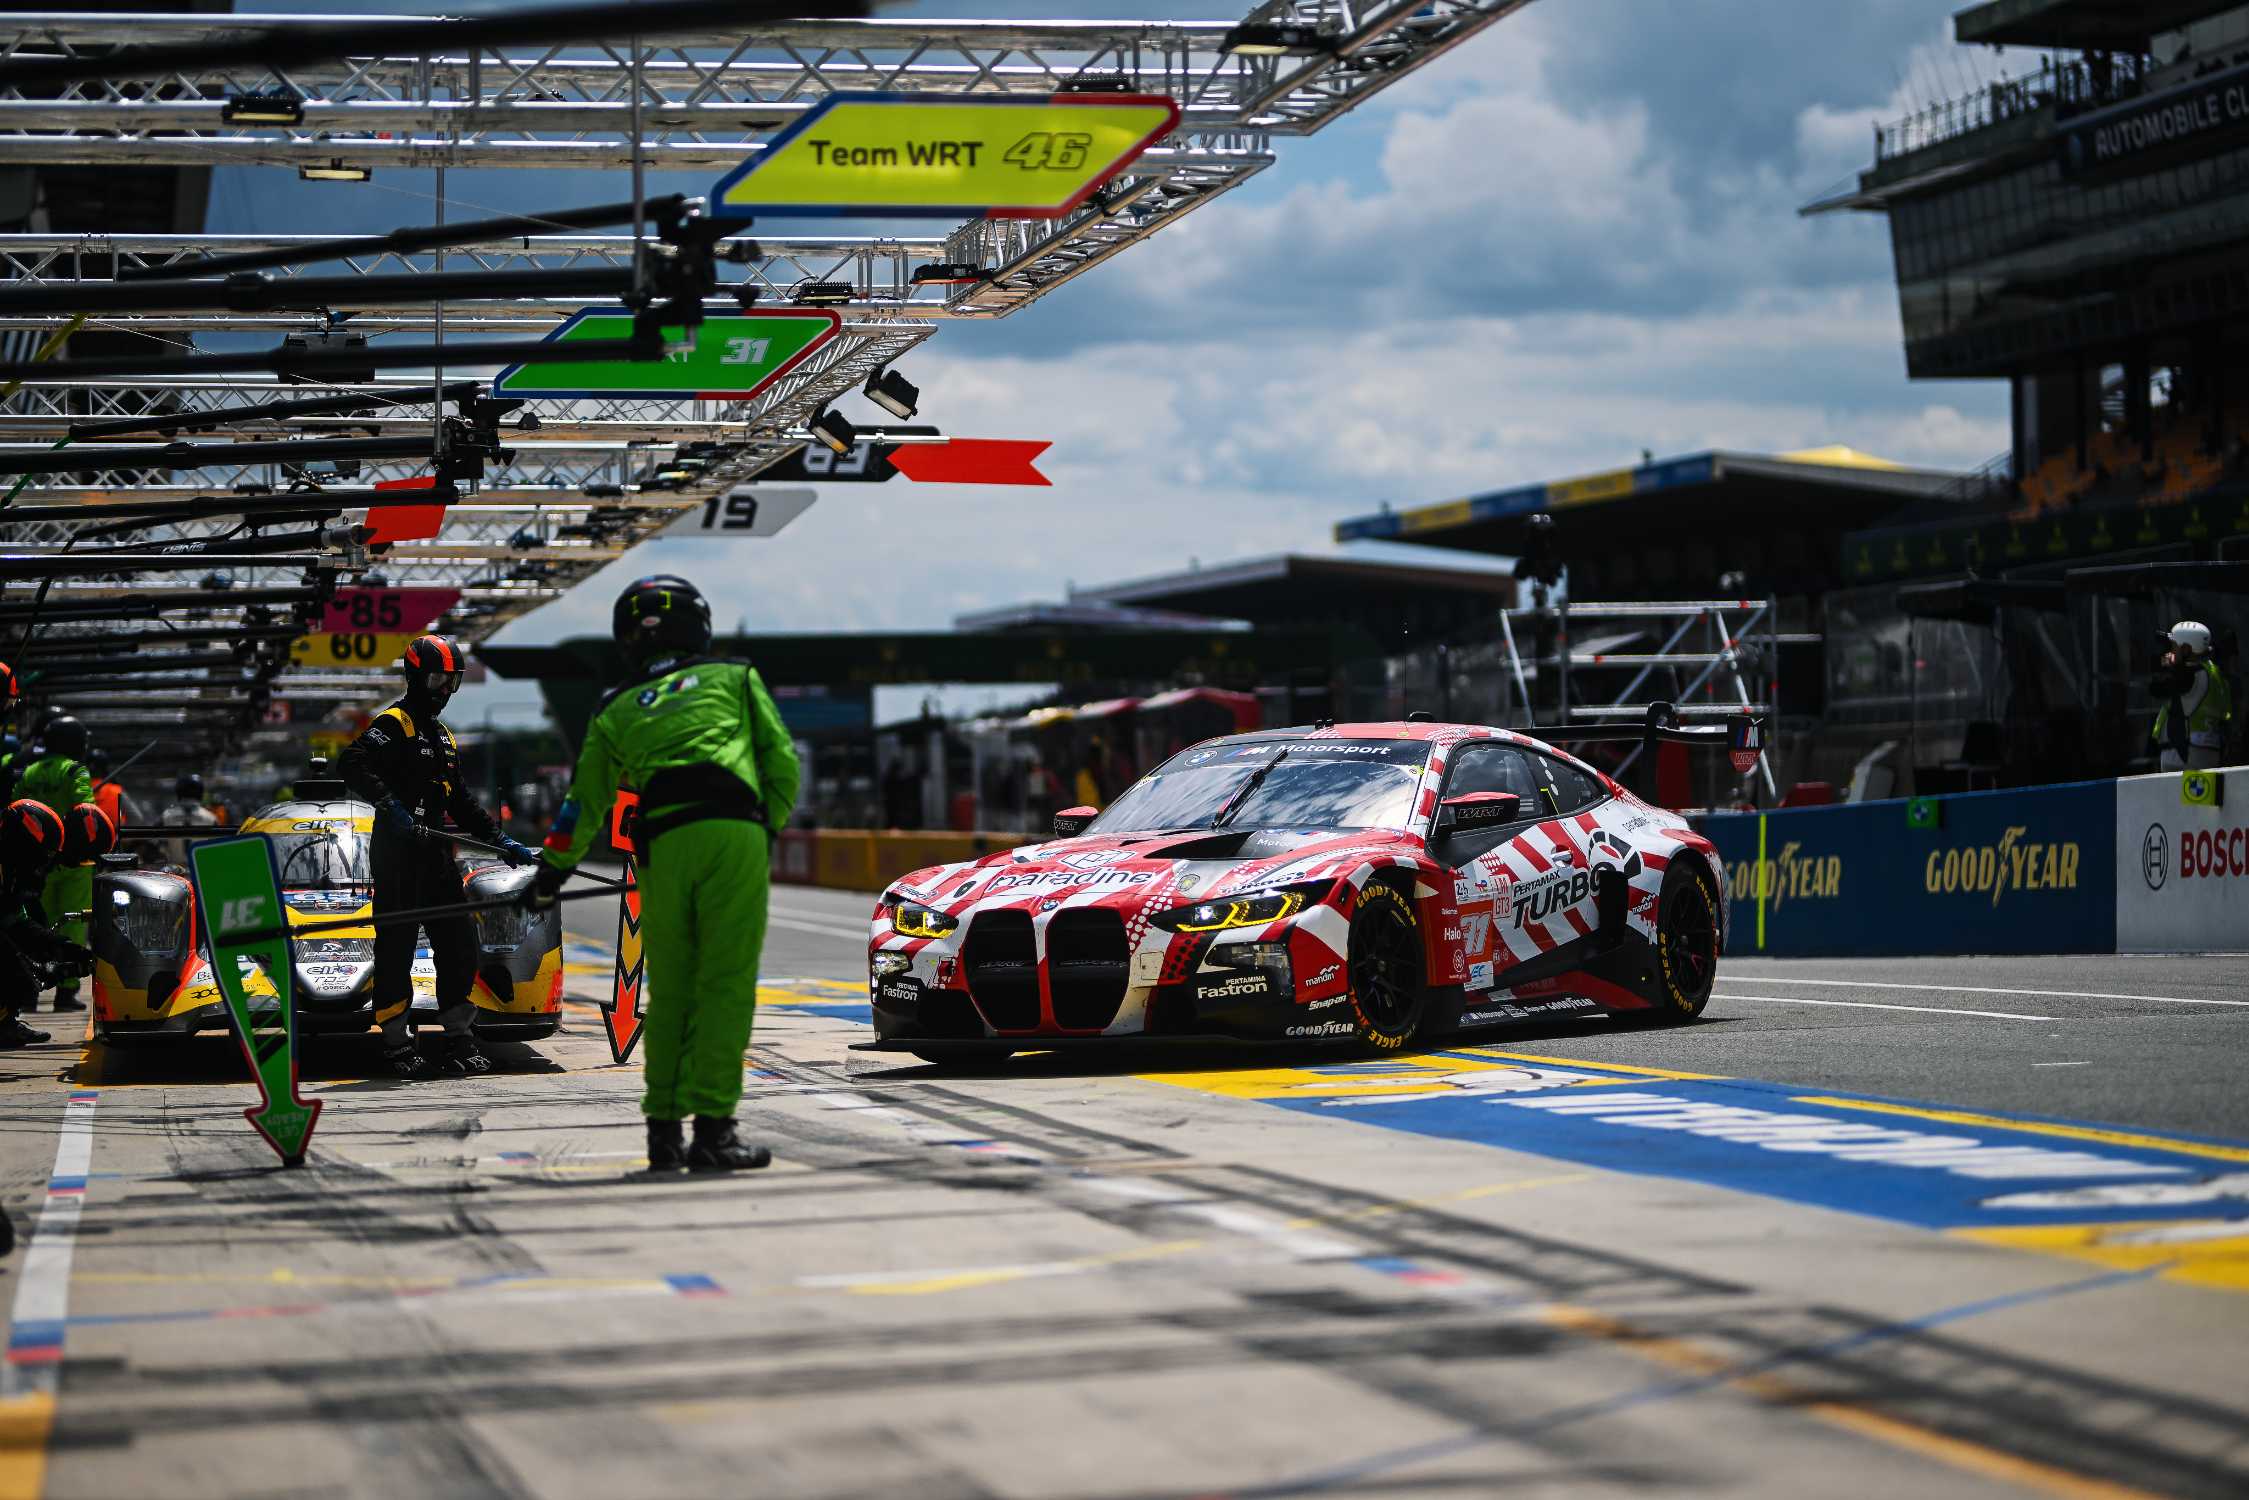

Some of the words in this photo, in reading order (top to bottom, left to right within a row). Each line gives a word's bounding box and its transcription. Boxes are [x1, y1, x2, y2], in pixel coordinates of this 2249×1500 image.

[2095, 93, 2221, 158] AUTOMOBILE
[809, 140, 898, 167] Team
[907, 141, 983, 166] WRT
[1003, 132, 1091, 169] 46
[720, 337, 772, 364] 31
[701, 494, 758, 529] 19
[350, 595, 399, 628] 85
[330, 633, 377, 660] 60
[1275, 744, 1391, 755] Motorsport
[1457, 805, 1505, 818] WRT
[1926, 834, 2080, 900] GOODYEAR
[989, 868, 1153, 891] paradine
[1513, 870, 1561, 897] PERTAMAX
[1495, 897, 1510, 914] GT3
[1444, 927, 1462, 941] Halo
[1197, 982, 1268, 999] Fastron
[1225, 975, 1266, 985] PERTAMINA
[883, 984, 917, 1001] Fastron
[1286, 1021, 1354, 1036] GOODYEAR
[1368, 1029, 1402, 1048] EAGLE
